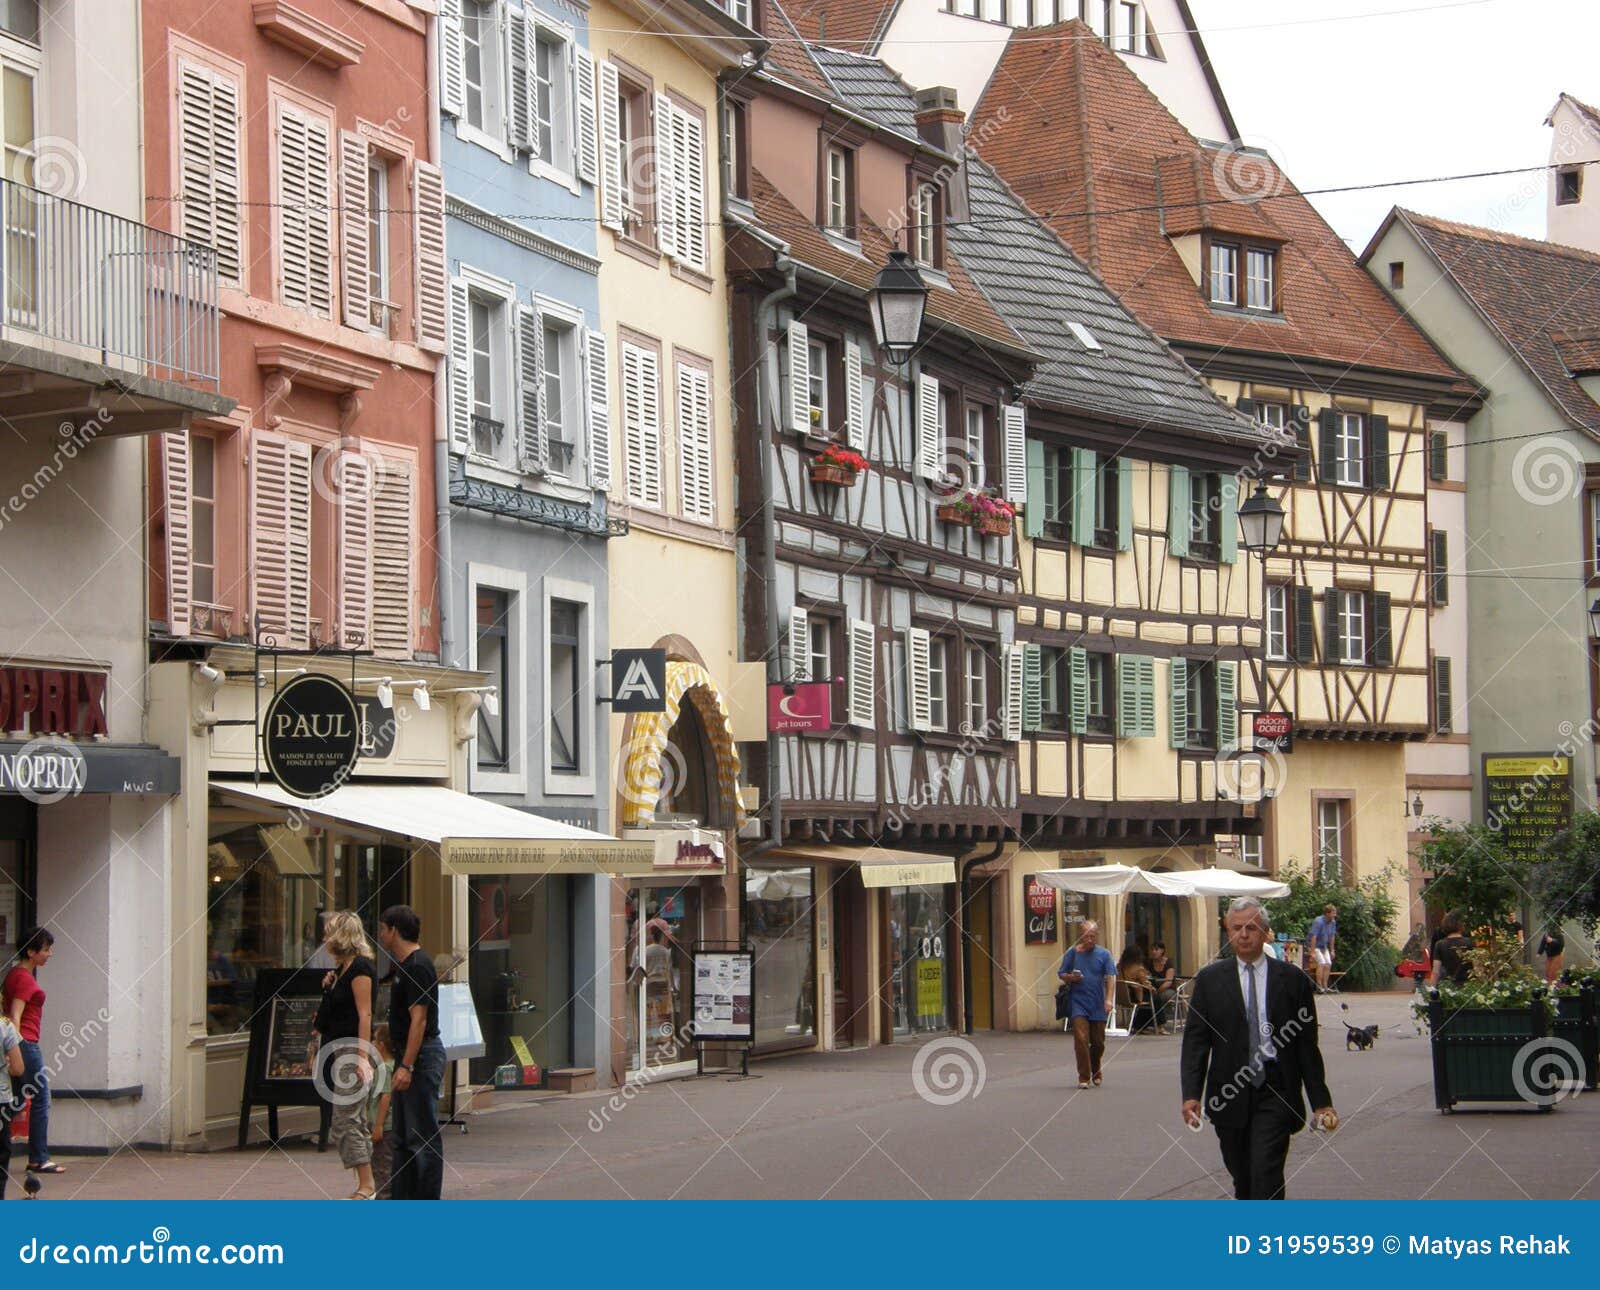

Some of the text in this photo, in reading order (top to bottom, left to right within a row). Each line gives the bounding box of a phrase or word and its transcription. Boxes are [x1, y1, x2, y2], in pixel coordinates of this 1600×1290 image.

[275, 714, 352, 737] PAUL
[790, 720, 813, 728] tours
[1256, 735, 1289, 754] Café
[314, 759, 326, 767] EN
[123, 780, 153, 792] MWC
[1539, 828, 1554, 837] LES
[1029, 911, 1055, 943] Café
